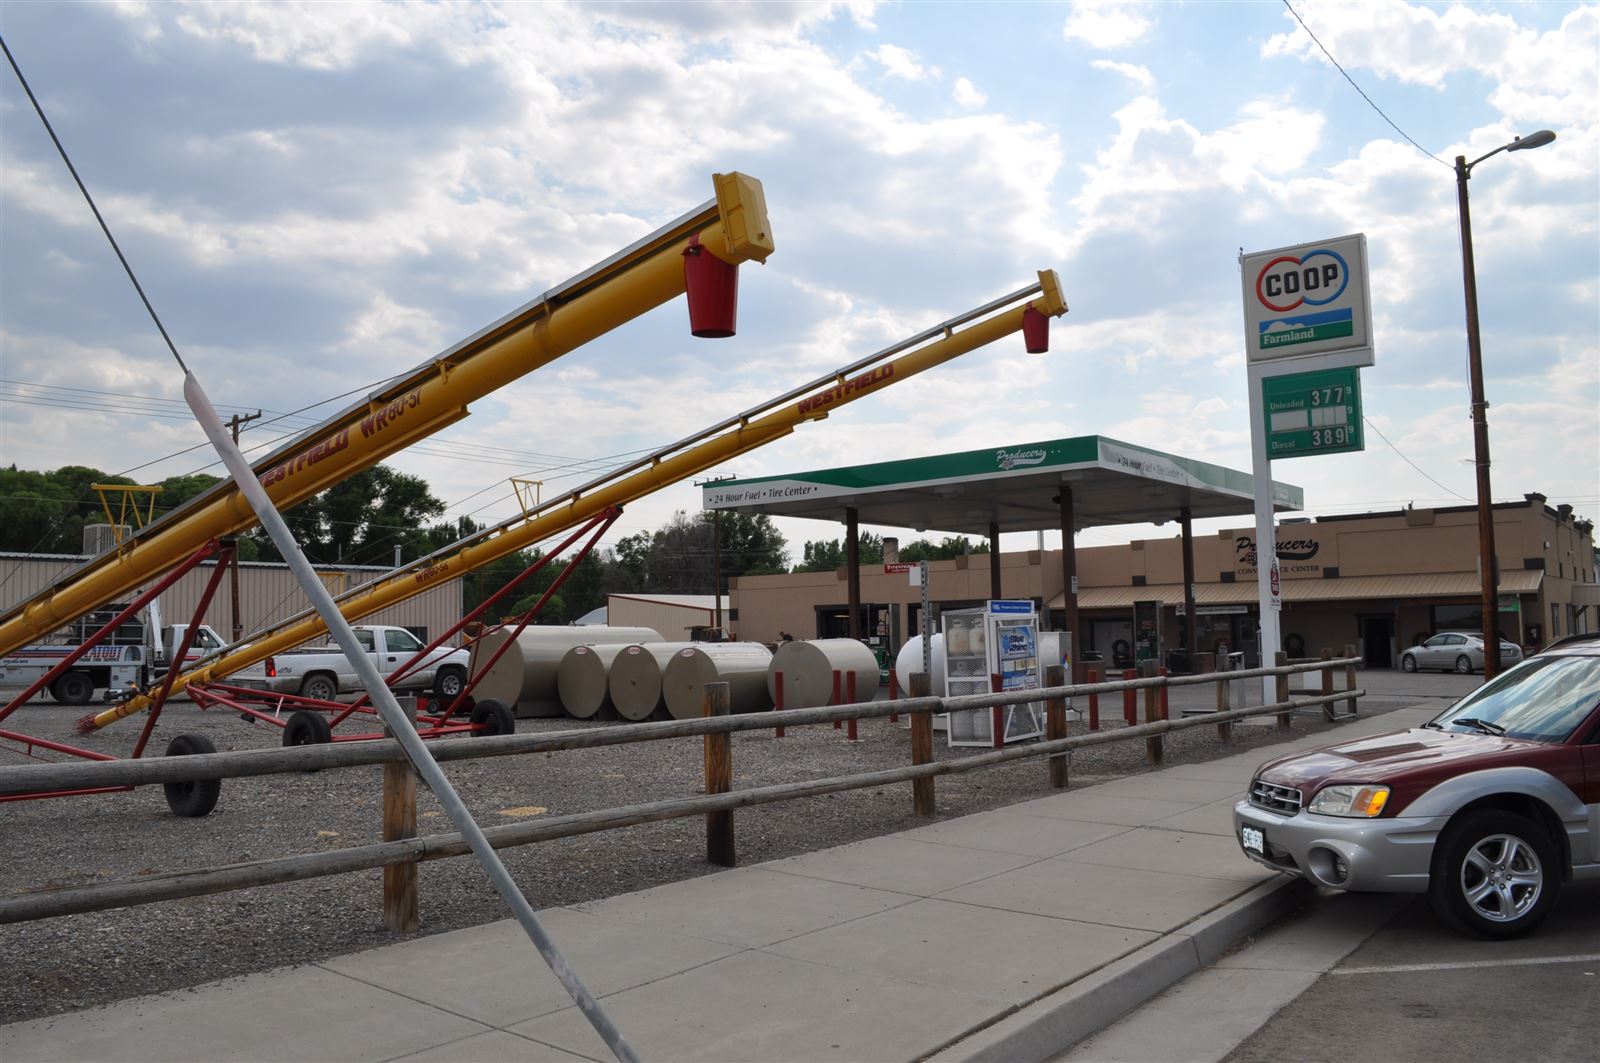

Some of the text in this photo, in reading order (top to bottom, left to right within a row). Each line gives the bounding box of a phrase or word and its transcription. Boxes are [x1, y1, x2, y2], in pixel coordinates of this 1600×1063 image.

[1265, 263, 1338, 297] COOP
[1263, 328, 1315, 345] Farmland
[797, 363, 895, 415] WESTFIELD
[1270, 399, 1304, 410] Unleaded
[1311, 387, 1343, 406] 377
[1271, 440, 1295, 449] Diesel
[1312, 428, 1344, 446] 389
[258, 429, 349, 488] ESTFIELD
[996, 448, 1046, 463] Producers
[714, 486, 811, 503] 24 Hour Fuel Tire Center
[1291, 565, 1319, 573] CENTER
